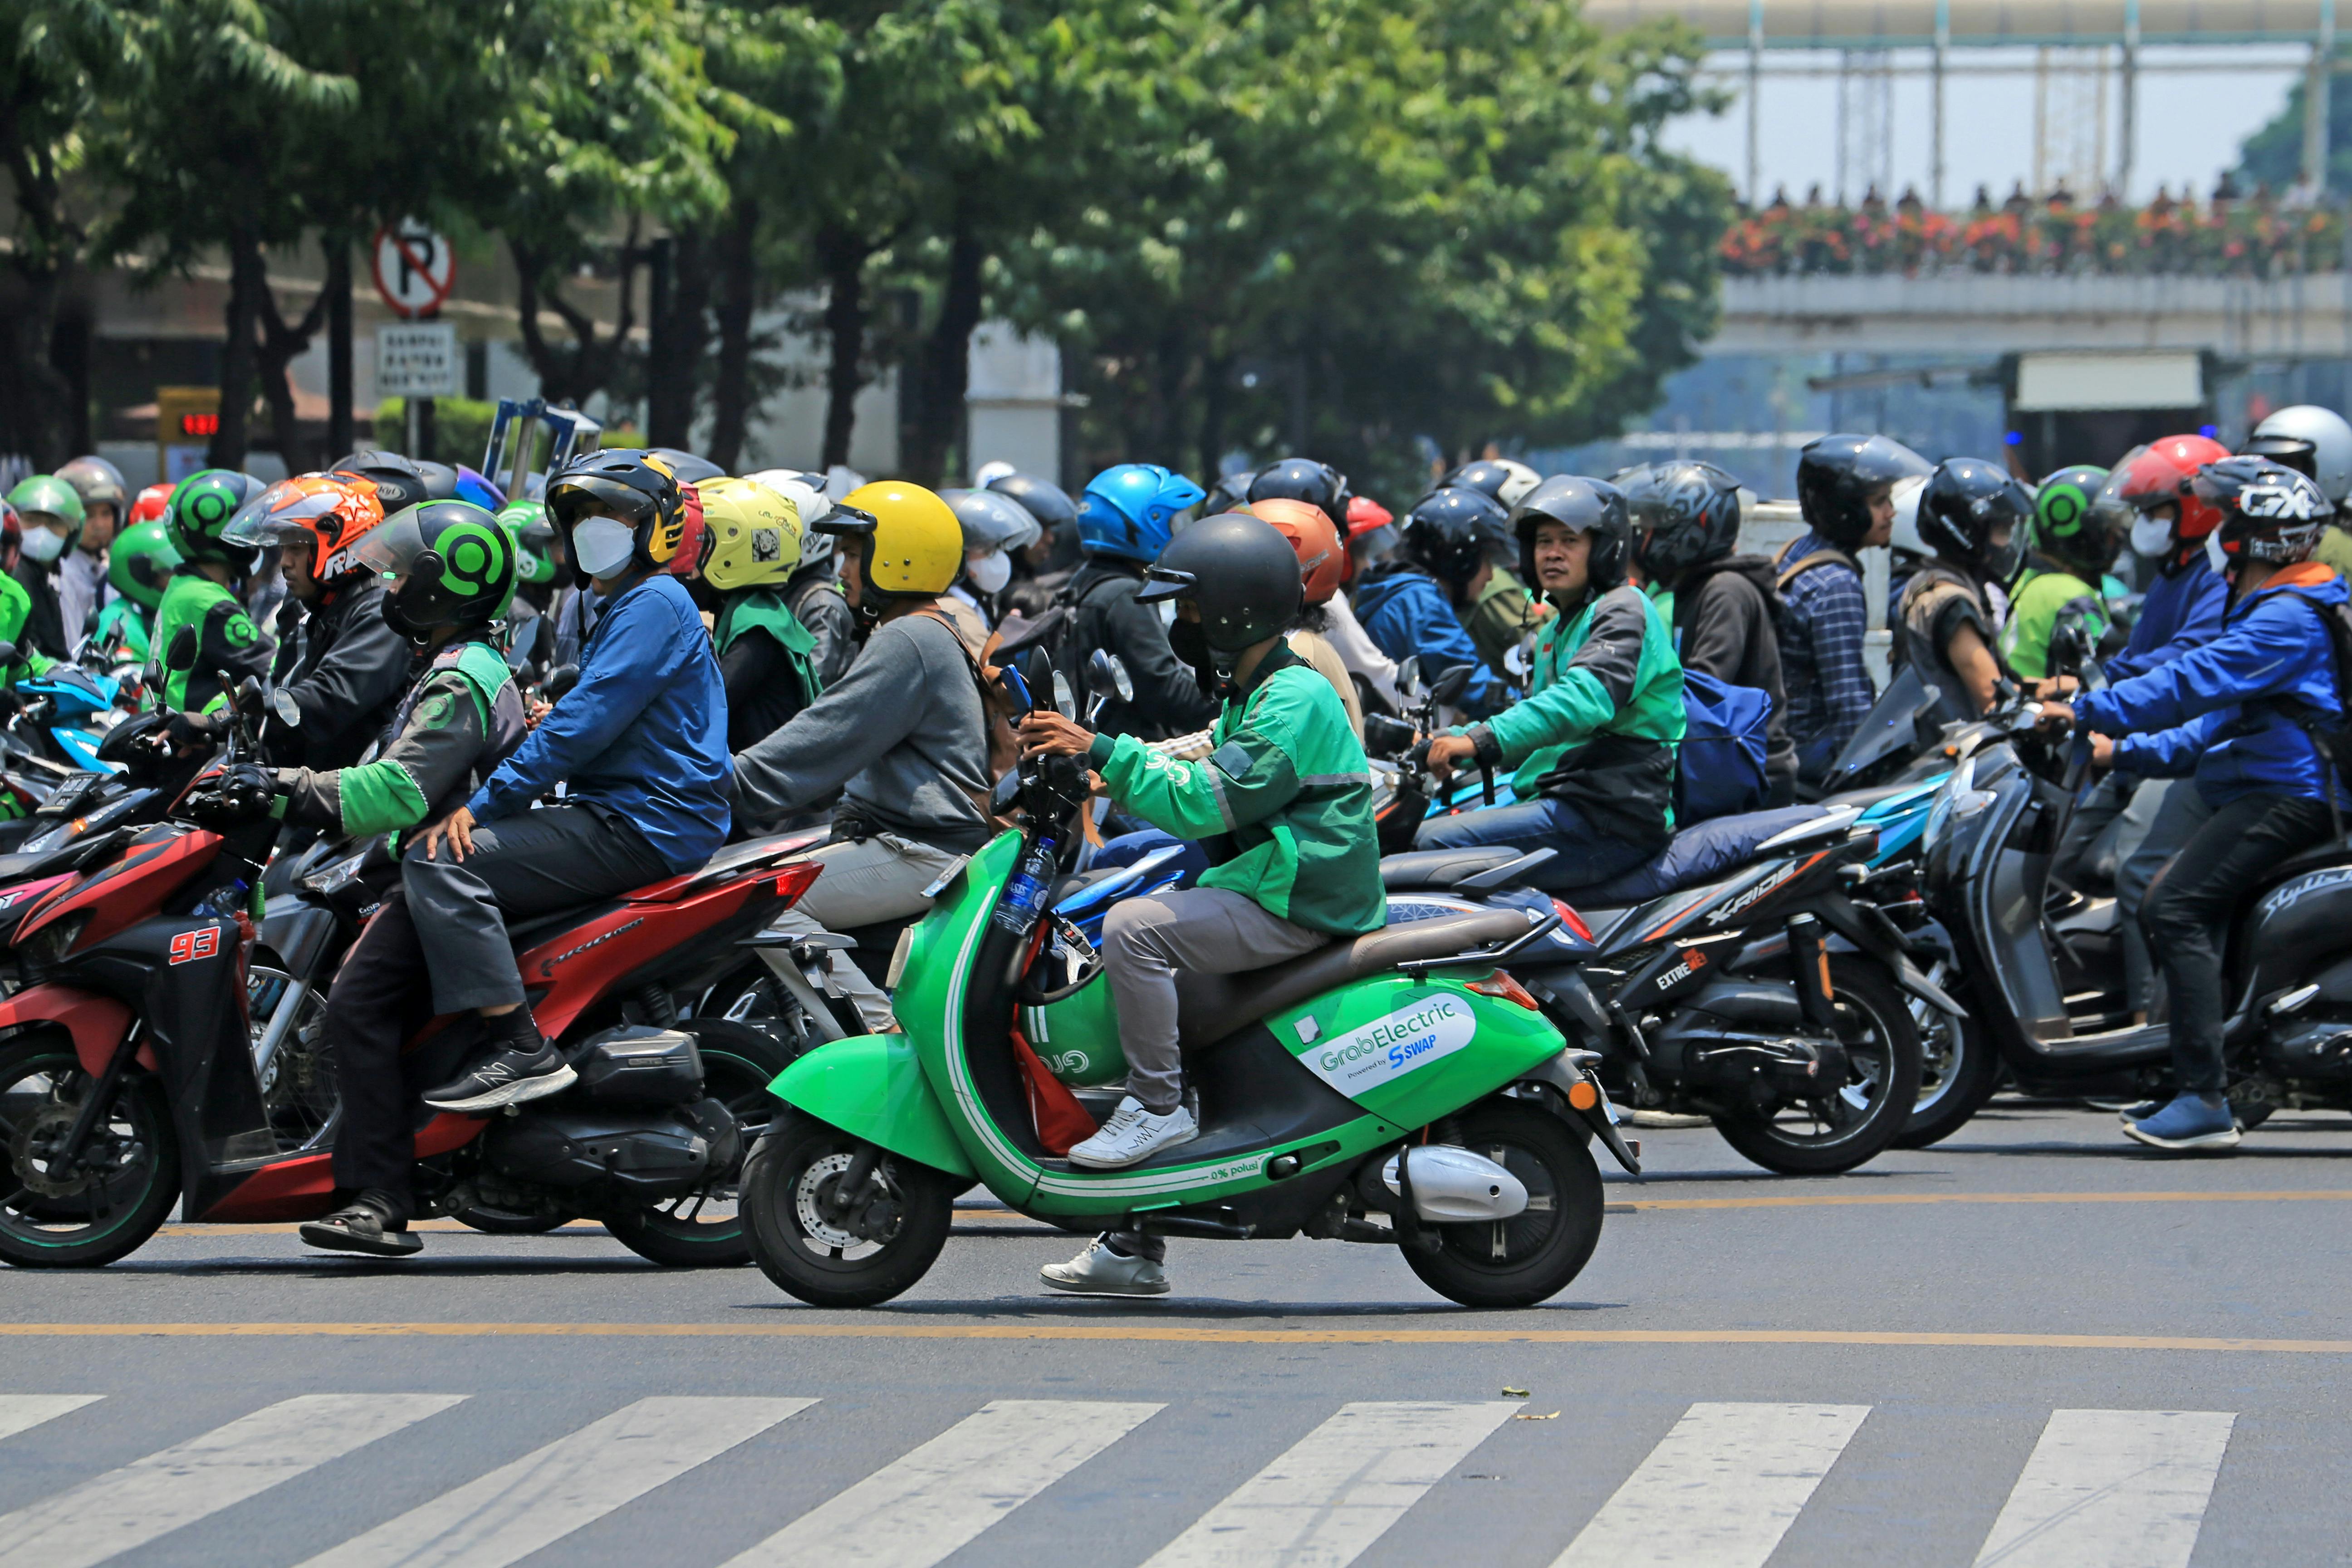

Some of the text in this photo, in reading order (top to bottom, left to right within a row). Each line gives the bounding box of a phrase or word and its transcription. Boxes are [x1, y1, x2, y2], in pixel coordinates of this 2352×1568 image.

[398, 236, 434, 296] P
[169, 926, 221, 966] 93
[1320, 1003, 1455, 1071] GrabElectric
[1347, 1062, 1377, 1079] Powered
[1377, 1058, 1387, 1068] by
[1404, 1034, 1436, 1059] SWAP
[1211, 1161, 1258, 1181] 0% polusi
